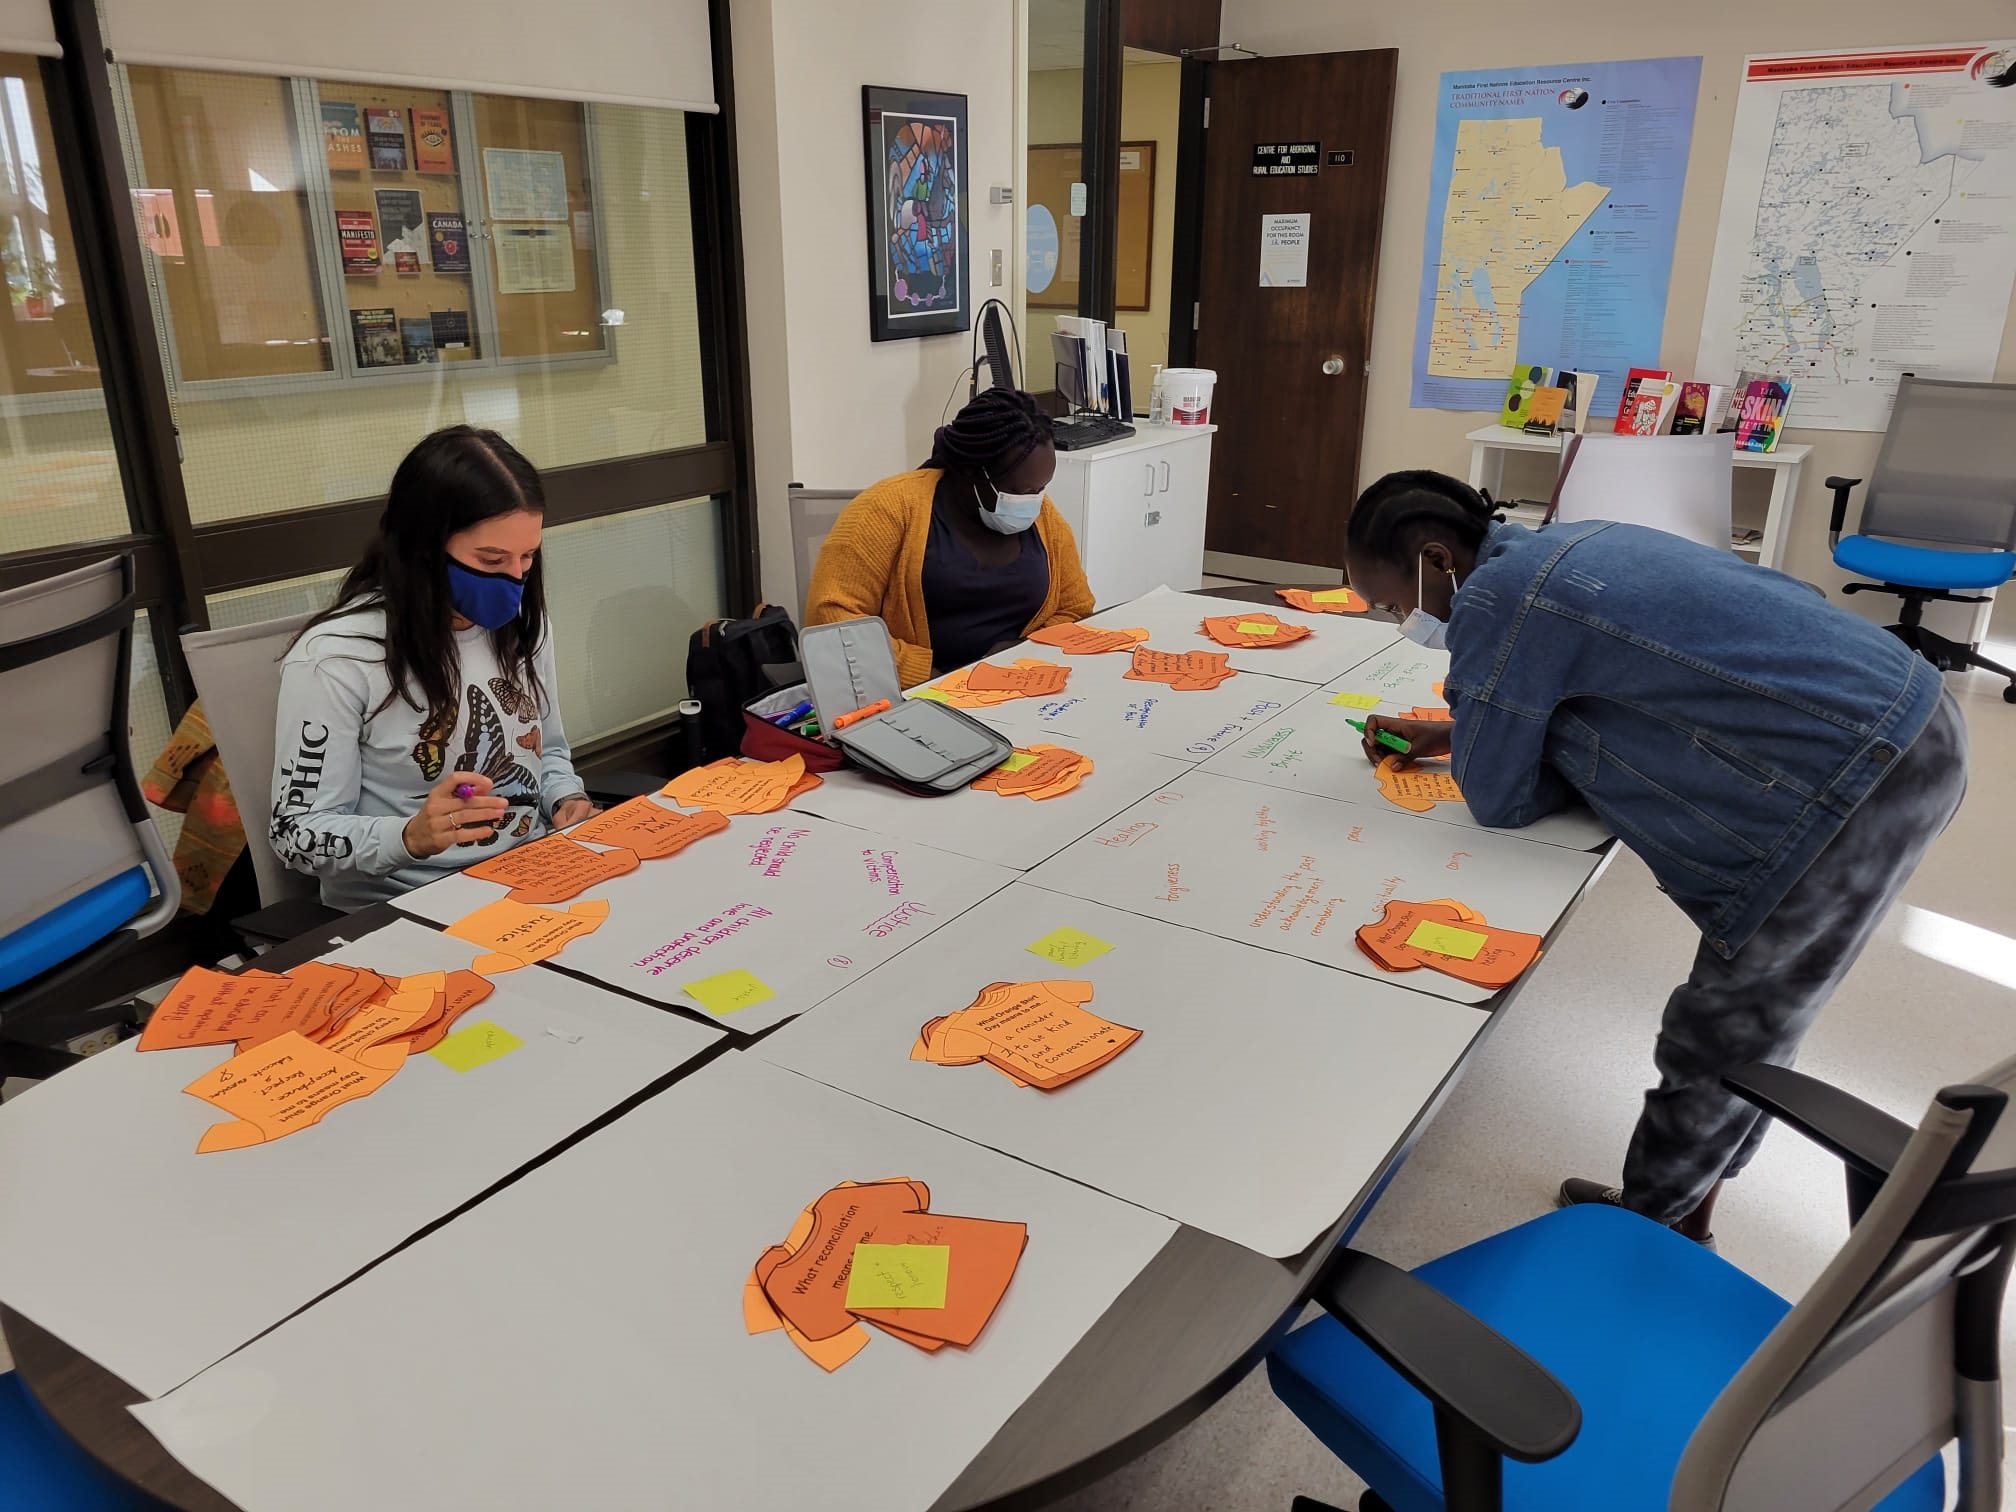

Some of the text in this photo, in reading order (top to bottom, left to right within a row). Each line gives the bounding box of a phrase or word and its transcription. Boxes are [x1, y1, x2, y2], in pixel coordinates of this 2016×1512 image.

[1451, 88, 1555, 100] TRADITIONAL FIRST NATION
[1450, 98, 1524, 109] COMMUNITY NAMES
[328, 144, 362, 152] ASHES
[1257, 144, 1317, 155] CENTRE FOR ABORIGINAL
[1280, 155, 1291, 164] AND
[1252, 165, 1318, 175] RURAL EDUCATION STUDIES
[433, 220, 463, 228] CANADA
[341, 230, 375, 239] MANIFESTO
[1741, 395, 1783, 421] SKIN
[1094, 821, 1159, 848] Healing
[696, 917, 723, 933] and
[866, 901, 936, 937] Justice
[496, 914, 554, 942] Justice
[646, 906, 773, 976] All children deserve
[977, 994, 1039, 1027] What Orange Shirt
[363, 1022, 376, 1031] me
[984, 1022, 1000, 1032] Day
[1000, 1011, 1022, 1025] means
[1015, 1011, 1055, 1034] reminder
[334, 1016, 401, 1054] Every child matt
[1014, 1043, 1029, 1052] to
[1028, 1034, 1046, 1043] be
[1031, 1044, 1054, 1059] and
[339, 1070, 361, 1082] Day
[307, 1080, 340, 1100] means
[278, 1075, 369, 1124] What Orange Shirt
[297, 1098, 309, 1106] to
[792, 1203, 861, 1295] What reconciliation
